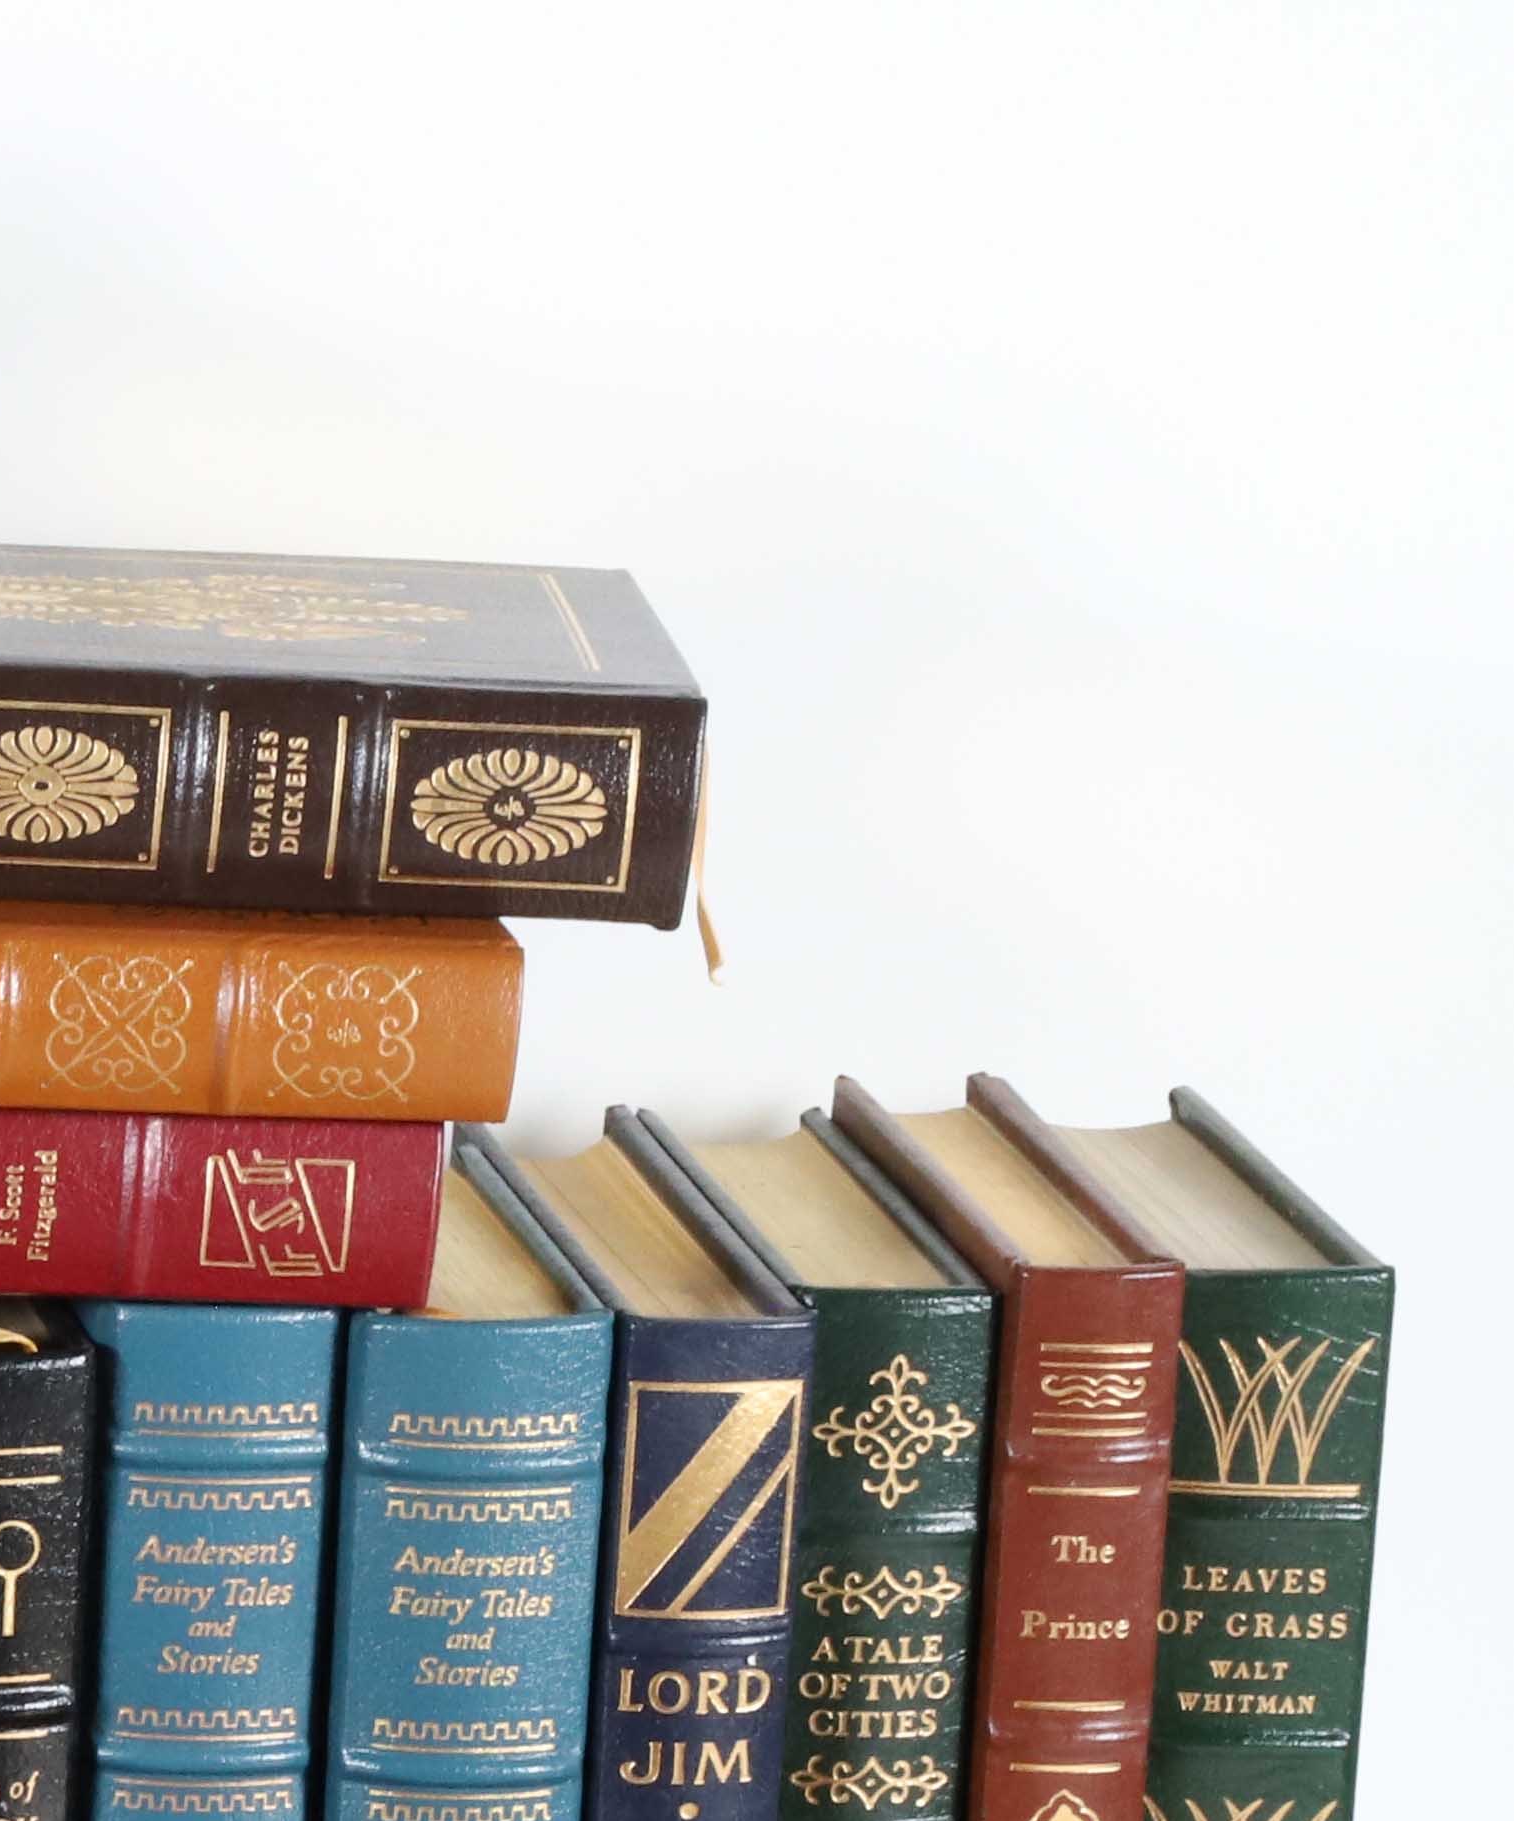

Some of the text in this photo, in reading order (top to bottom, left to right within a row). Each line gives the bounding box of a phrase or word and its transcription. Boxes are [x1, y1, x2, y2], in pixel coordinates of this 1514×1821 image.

[248, 728, 280, 859] CHARLES
[279, 735, 310, 856] DICKENS
[26, 1148, 59, 1262] Fitzgerald
[133, 1532, 296, 1567] Andersen's
[393, 1545, 556, 1580] Andersen's
[1049, 1534, 1116, 1565] The
[130, 1577, 295, 1610] Fairy Tales
[1181, 1564, 1329, 1595] LEAVES
[387, 1587, 554, 1620] Fairy Tales
[1018, 1609, 1131, 1642] Prince
[1224, 1611, 1350, 1640] GRASS
[155, 1645, 260, 1676] Stories
[849, 1634, 944, 1664] TALE
[413, 1658, 520, 1688] Stories
[1207, 1660, 1289, 1682] WALT
[616, 1667, 771, 1715] LORD
[1176, 1691, 1318, 1716] WHITMAN
[807, 1708, 938, 1741] CITIES
[617, 1738, 753, 1786] JIM
